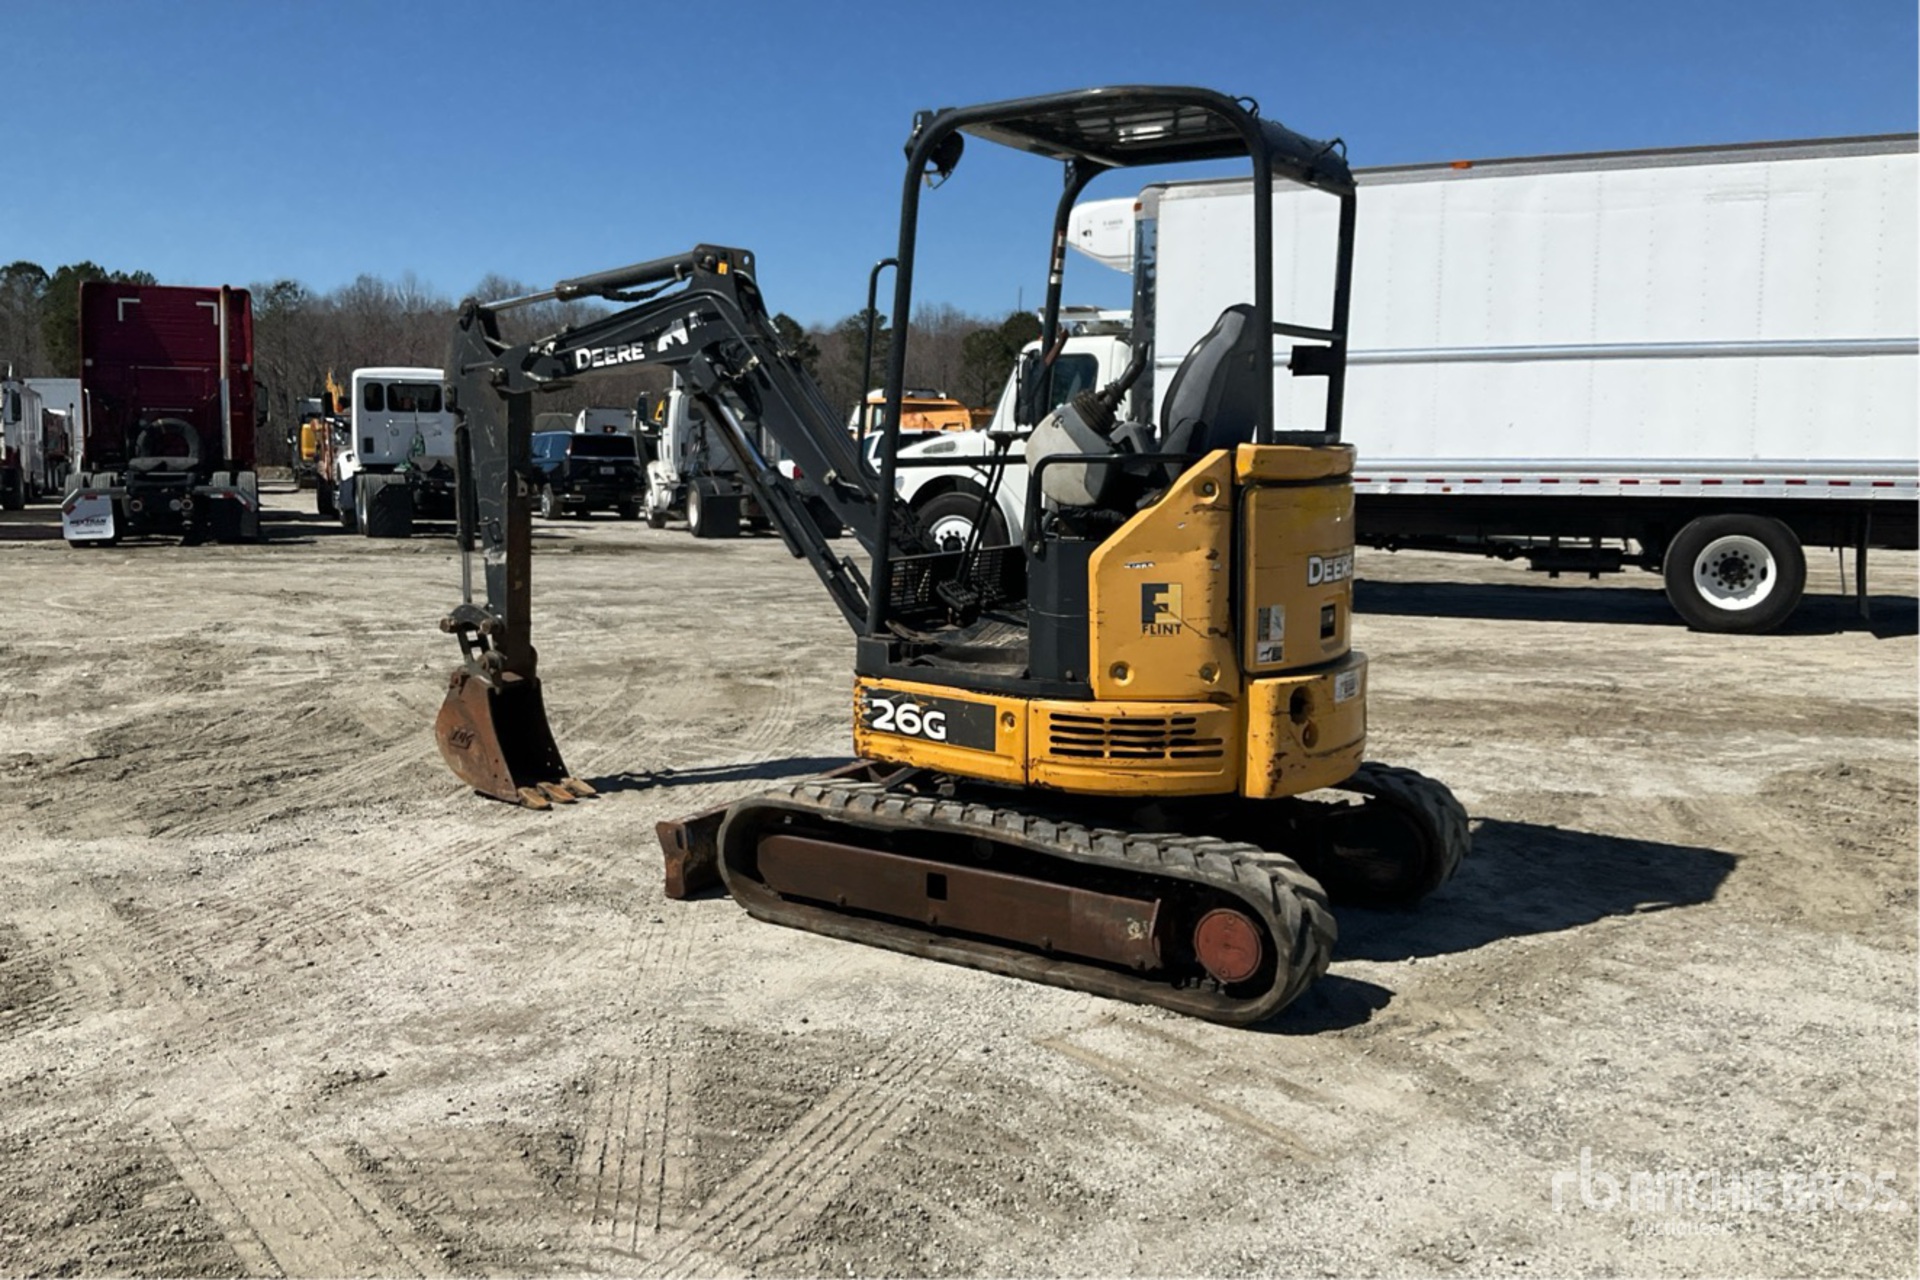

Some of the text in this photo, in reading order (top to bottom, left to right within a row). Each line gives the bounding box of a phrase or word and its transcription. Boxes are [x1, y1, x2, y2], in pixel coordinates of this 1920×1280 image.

[575, 342, 645, 369] DEERE
[1141, 624, 1182, 635] FLINT
[872, 699, 947, 740] 26G
